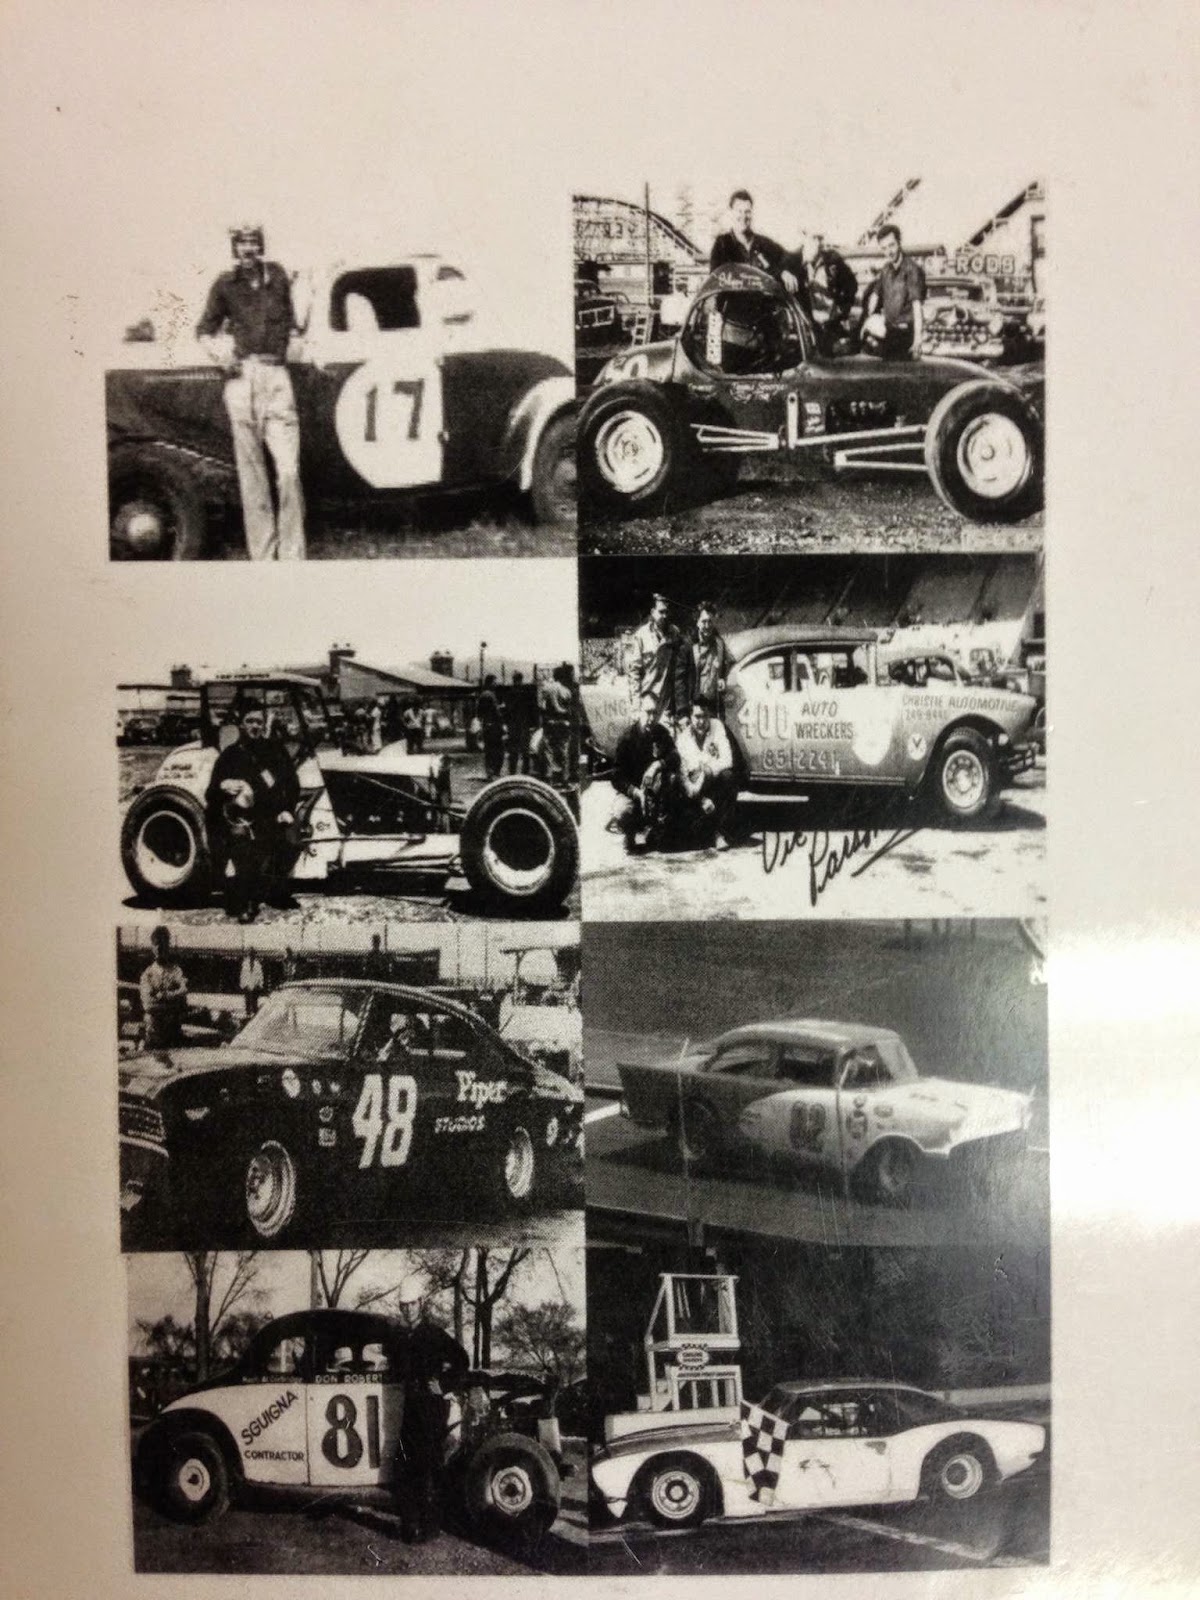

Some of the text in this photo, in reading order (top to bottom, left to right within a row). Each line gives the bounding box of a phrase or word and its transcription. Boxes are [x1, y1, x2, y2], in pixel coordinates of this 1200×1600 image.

[363, 378, 425, 442] 17
[801, 700, 838, 718] AUTO
[794, 721, 853, 740] WRECKERS
[352, 1073, 418, 1169] 48
[315, 1374, 338, 1384] DON
[241, 1390, 299, 1446] SGUIGNA
[321, 1393, 381, 1469] 81
[244, 1450, 305, 1462] CONTRACTOR
